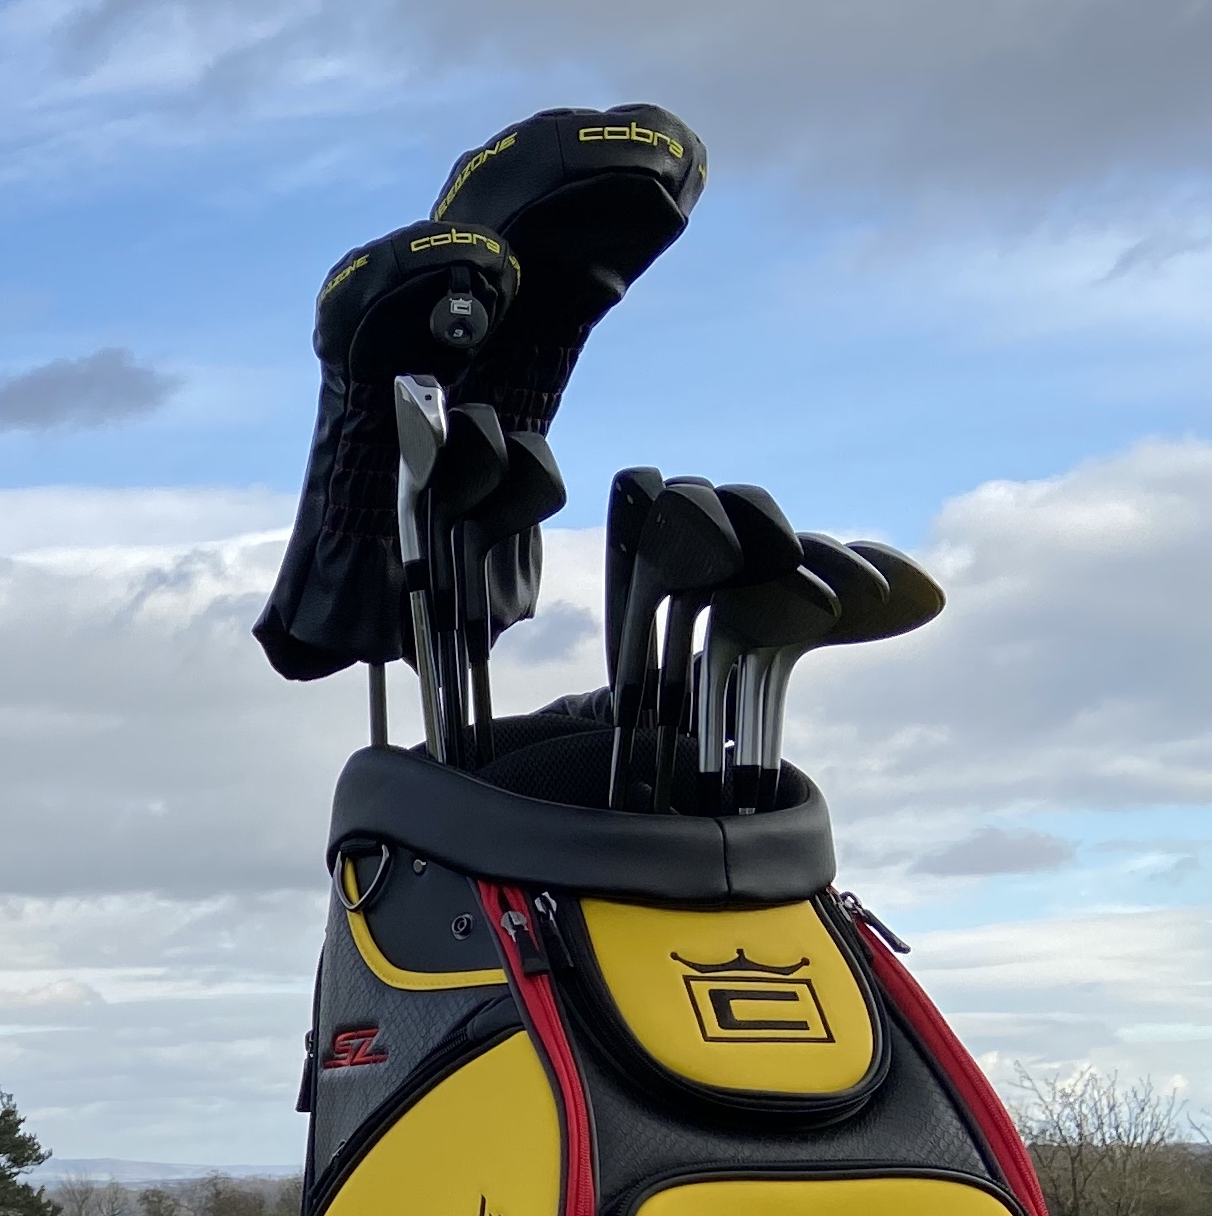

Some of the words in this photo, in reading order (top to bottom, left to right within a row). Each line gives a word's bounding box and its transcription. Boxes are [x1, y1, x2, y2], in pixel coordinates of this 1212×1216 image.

[579, 121, 684, 158] cobra
[410, 228, 500, 254] cobra
[323, 1028, 389, 1069] SZ
